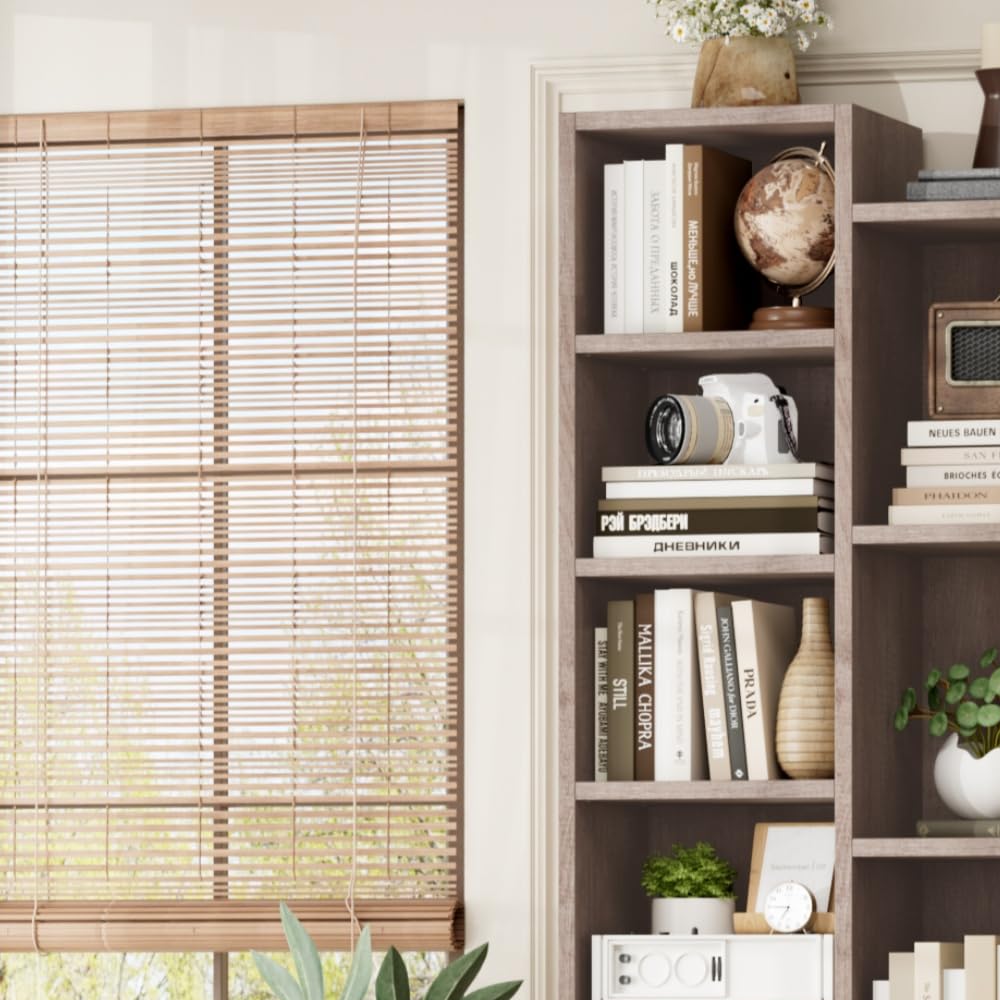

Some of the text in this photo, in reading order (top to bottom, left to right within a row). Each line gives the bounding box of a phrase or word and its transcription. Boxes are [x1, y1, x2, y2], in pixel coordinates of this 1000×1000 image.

[929, 428, 960, 438] NEUES
[963, 428, 997, 437] BAUEN
[963, 451, 987, 460] SAN
[944, 471, 987, 480] BRIOCHES
[923, 491, 988, 500] PHAIDON
[601, 512, 688, 531] РЭЙ БРЭДБЕРИ
[653, 541, 740, 553] ДНЕВНИКИ
[638, 624, 652, 751] MALLIKA CHOPRA
[743, 668, 757, 719] PRADA
[612, 678, 627, 710] STILL
